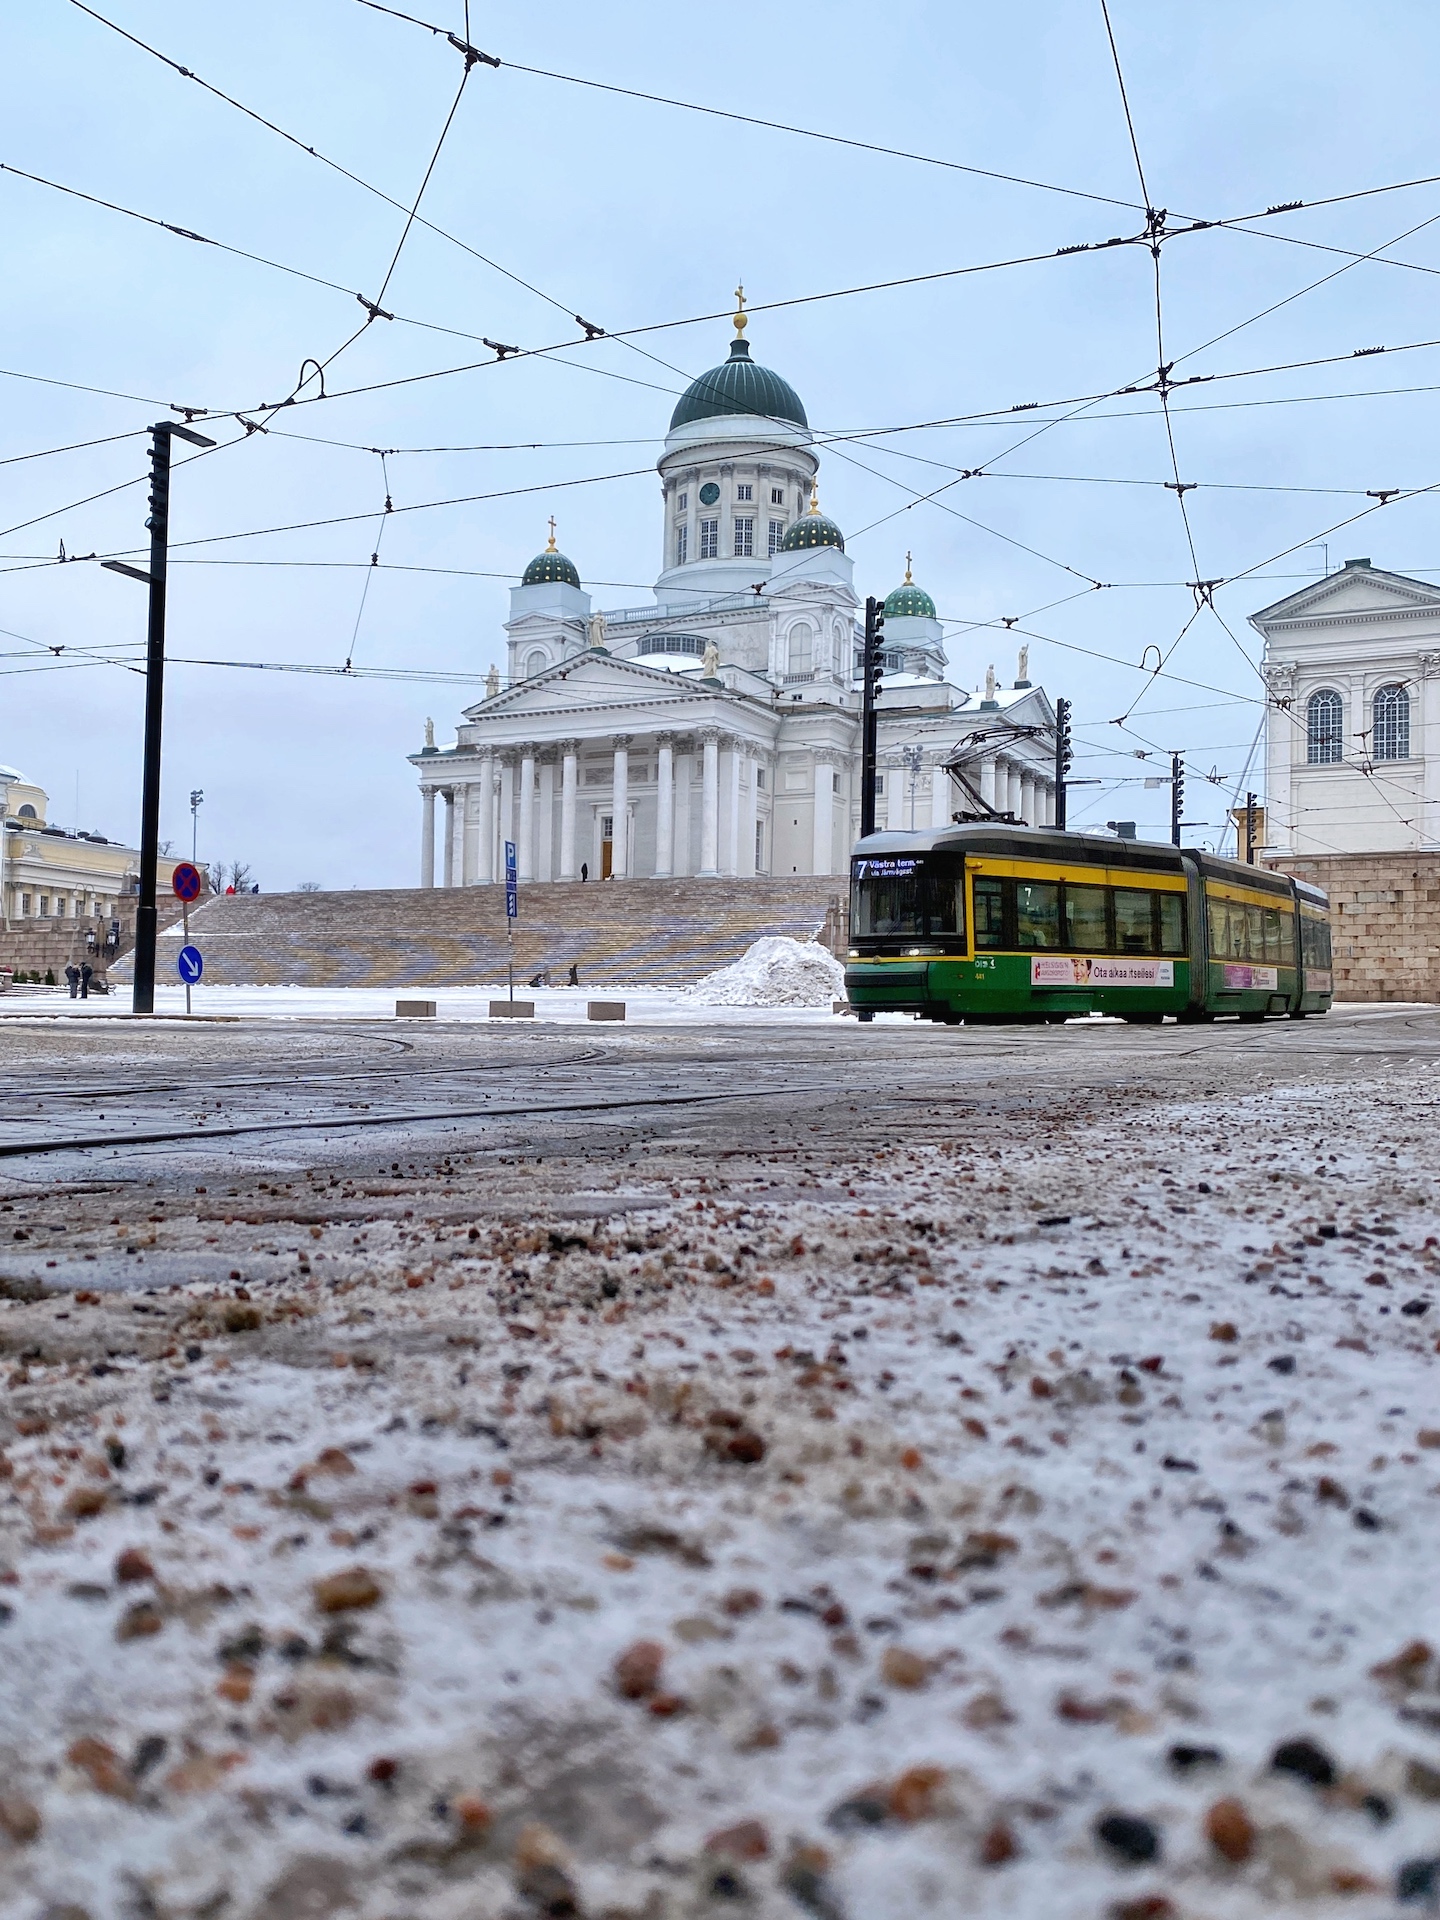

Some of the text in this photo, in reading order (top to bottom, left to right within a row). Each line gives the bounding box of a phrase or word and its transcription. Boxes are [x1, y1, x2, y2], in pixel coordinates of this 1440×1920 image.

[507, 844, 514, 866] P
[857, 861, 867, 879] 7
[869, 860, 895, 868] Västra
[1024, 887, 1031, 898] 7
[1094, 966, 1107, 978] Ota
[1109, 967, 1127, 978] aikaa
